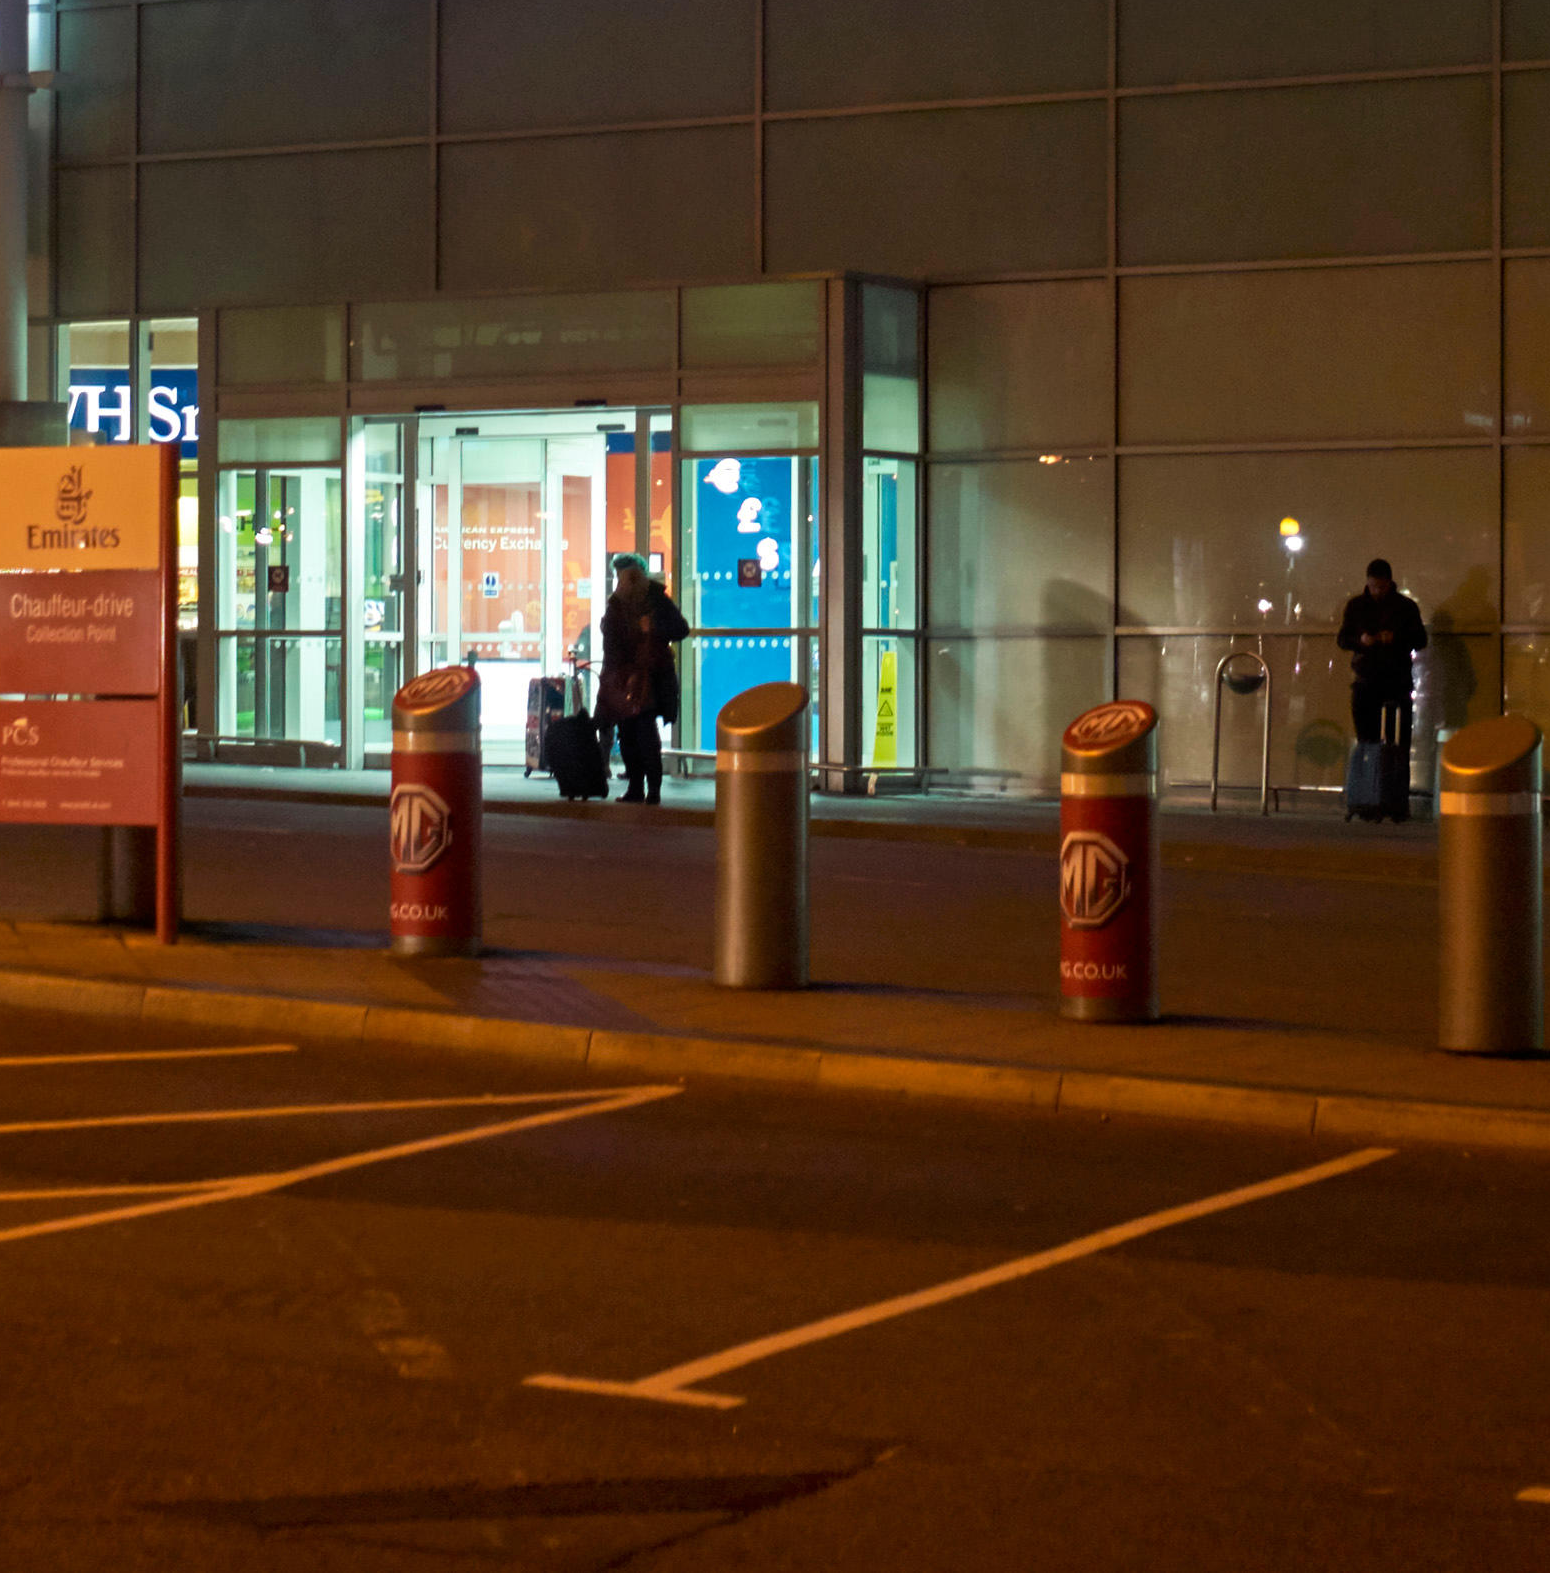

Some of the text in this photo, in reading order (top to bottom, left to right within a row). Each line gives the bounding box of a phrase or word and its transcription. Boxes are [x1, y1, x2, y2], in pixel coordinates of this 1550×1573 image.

[27, 524, 120, 550] Emirates
[434, 536, 569, 552] Cuency Exchae
[10, 592, 135, 619] Chauffeur-drive
[26, 625, 84, 643] Collection
[2, 726, 40, 746] PCS
